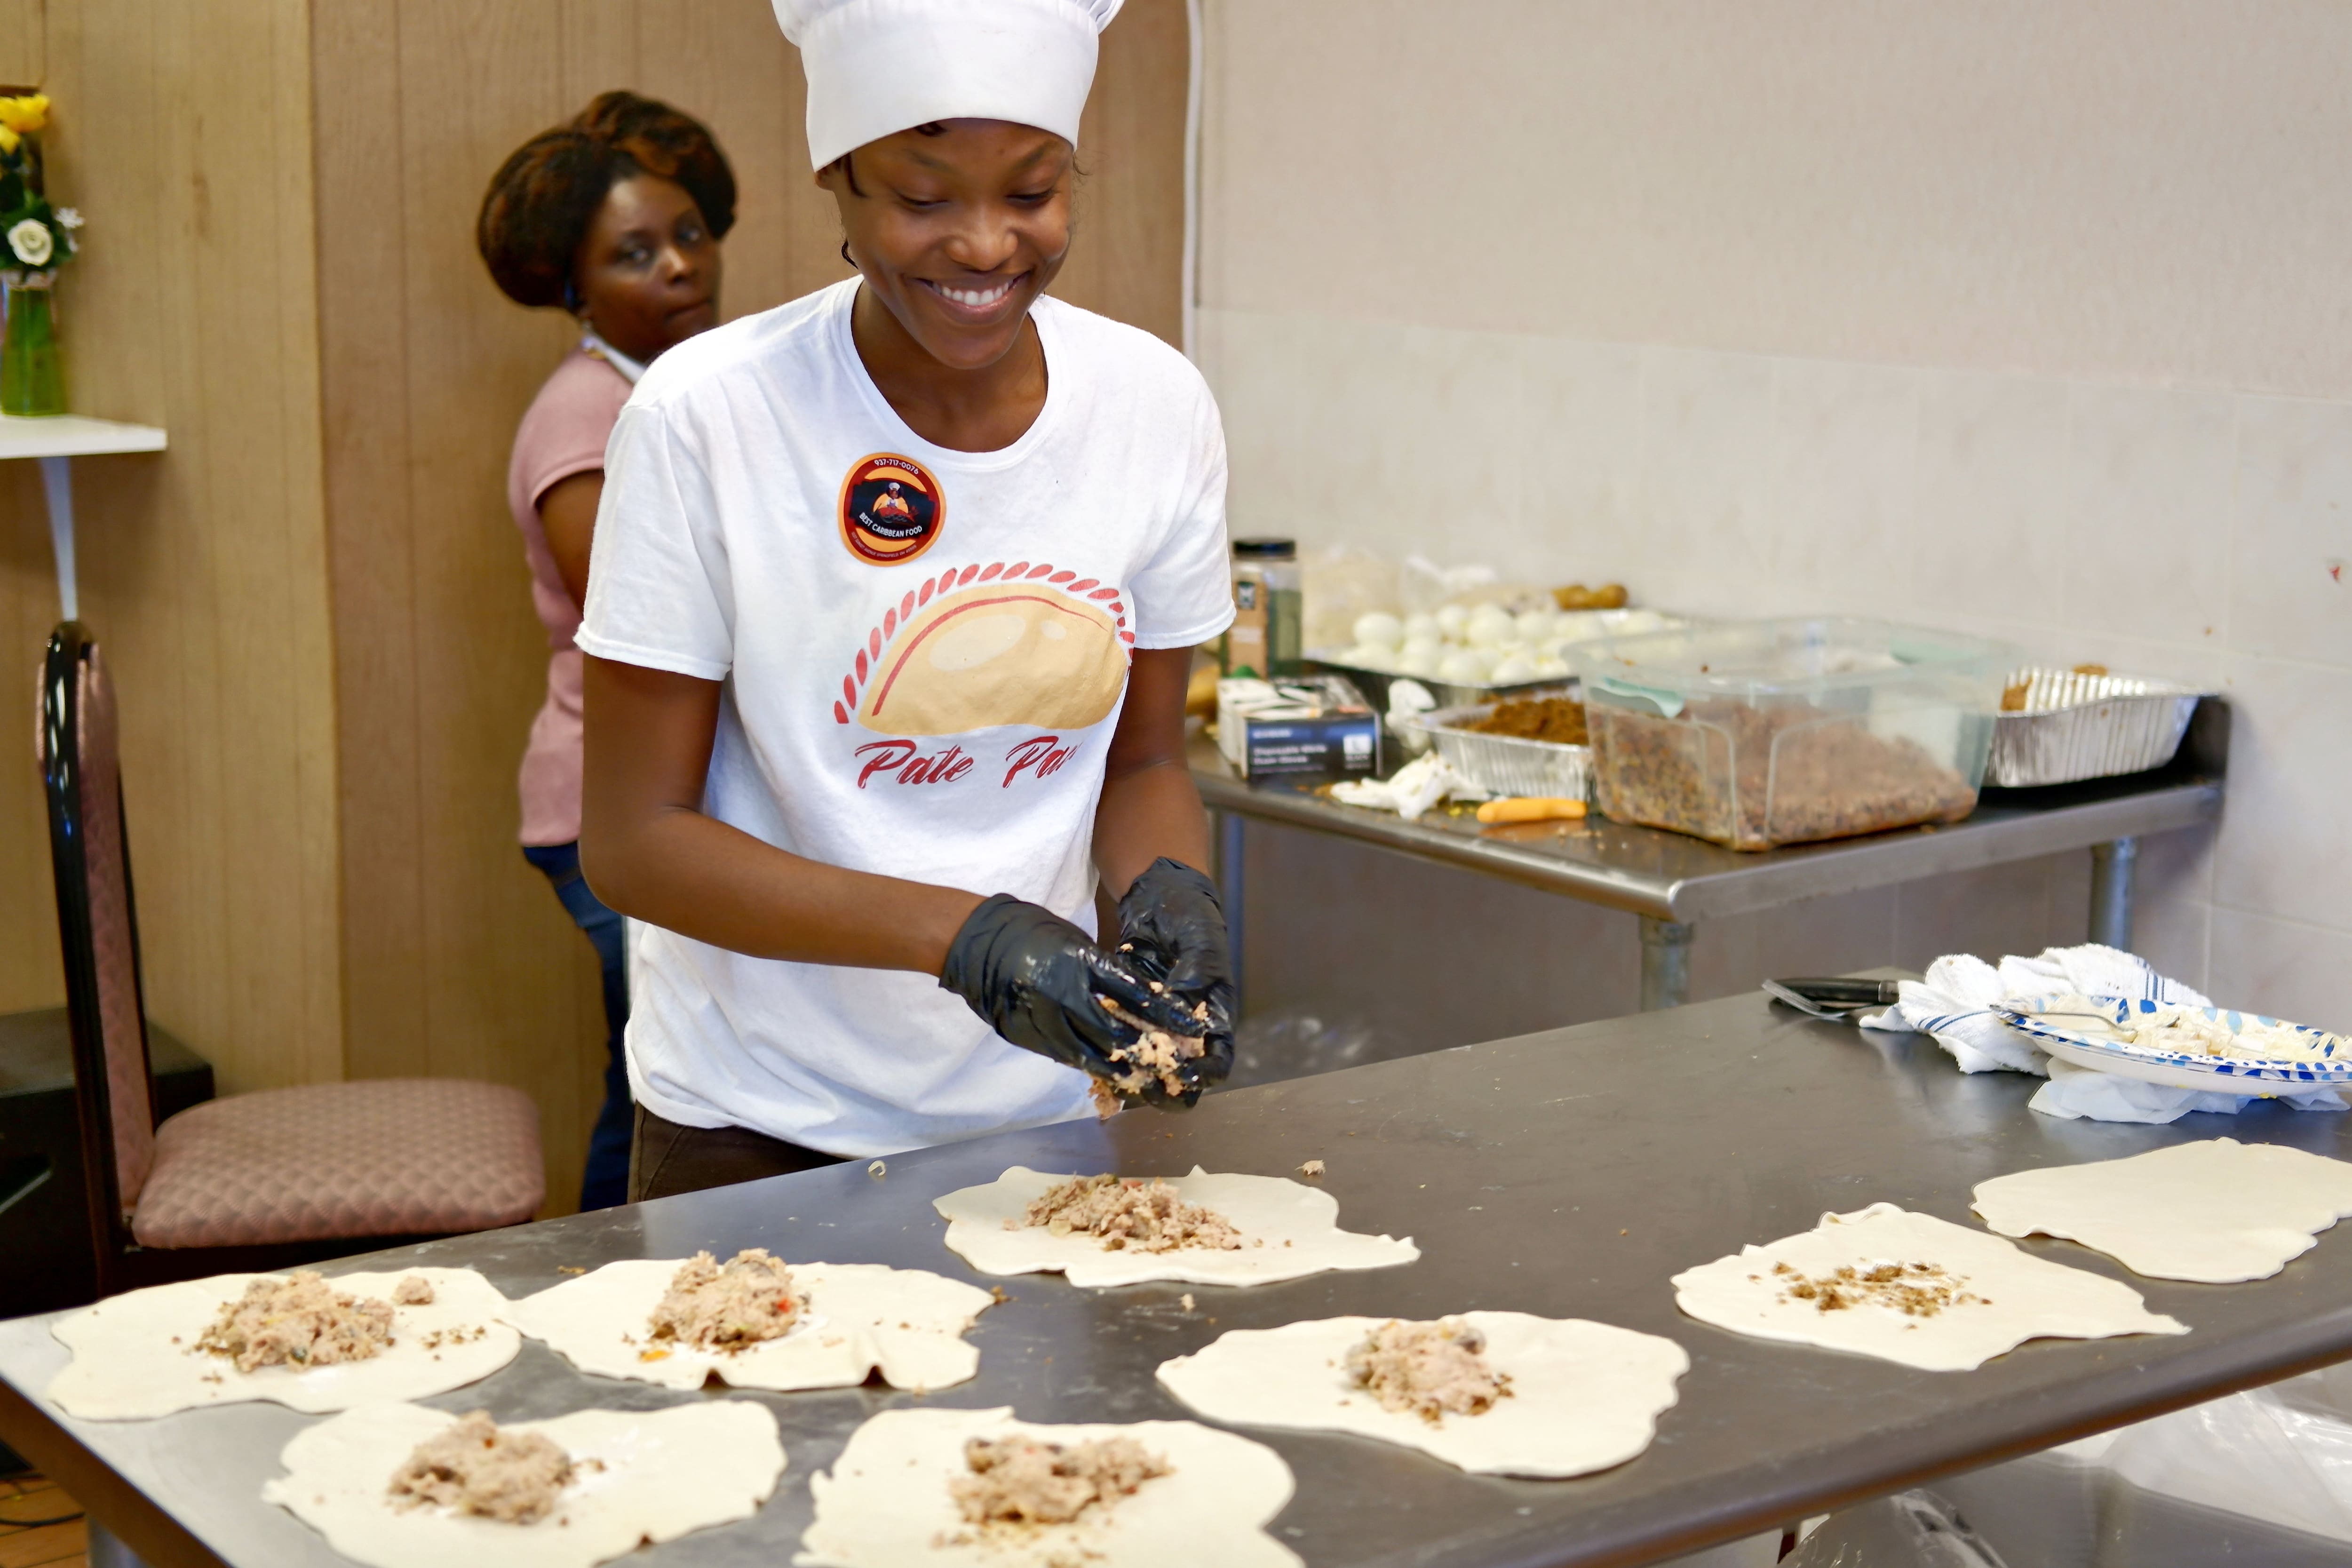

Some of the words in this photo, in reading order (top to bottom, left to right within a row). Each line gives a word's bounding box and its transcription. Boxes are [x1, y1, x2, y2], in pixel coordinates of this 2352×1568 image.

[874, 458, 919, 475] 937-717-0076
[859, 512, 873, 526] BEST
[872, 523, 904, 537] CARIBBEAN
[905, 525, 922, 537] FOOD
[855, 739, 974, 789] Pate
